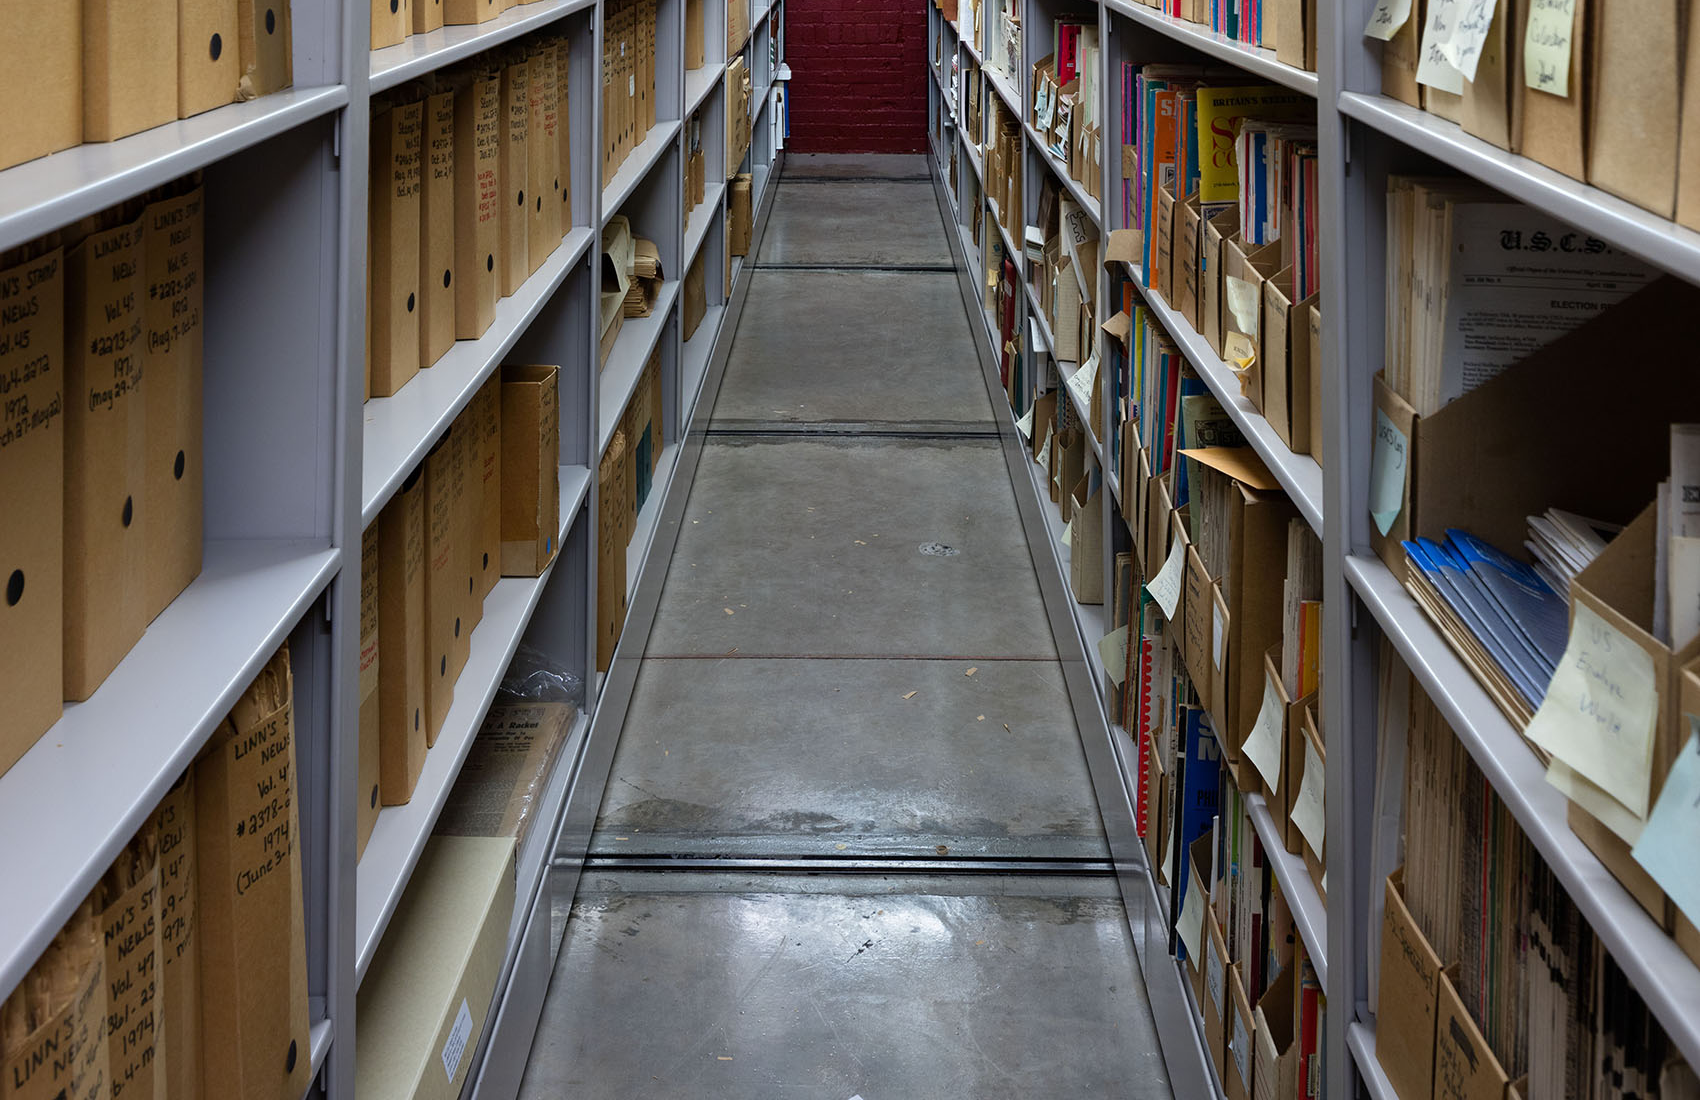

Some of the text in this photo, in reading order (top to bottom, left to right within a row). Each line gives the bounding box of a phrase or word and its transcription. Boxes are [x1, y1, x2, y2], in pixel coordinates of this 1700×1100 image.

[1214, 97, 1257, 107] BRITAIN'S
[2, 296, 40, 328] NEWS
[1551, 300, 1599, 311] ELECTION
[5, 394, 29, 423] 1972
[234, 719, 277, 761] LINN'S
[508, 721, 539, 729] Racket
[257, 775, 277, 799] Vol.
[263, 820, 289, 852] 1974
[236, 857, 273, 896] (June
[117, 915, 155, 962] NEWS
[112, 970, 133, 1001] Vol.
[138, 950, 155, 977] 47
[123, 1012, 155, 1056] 1974
